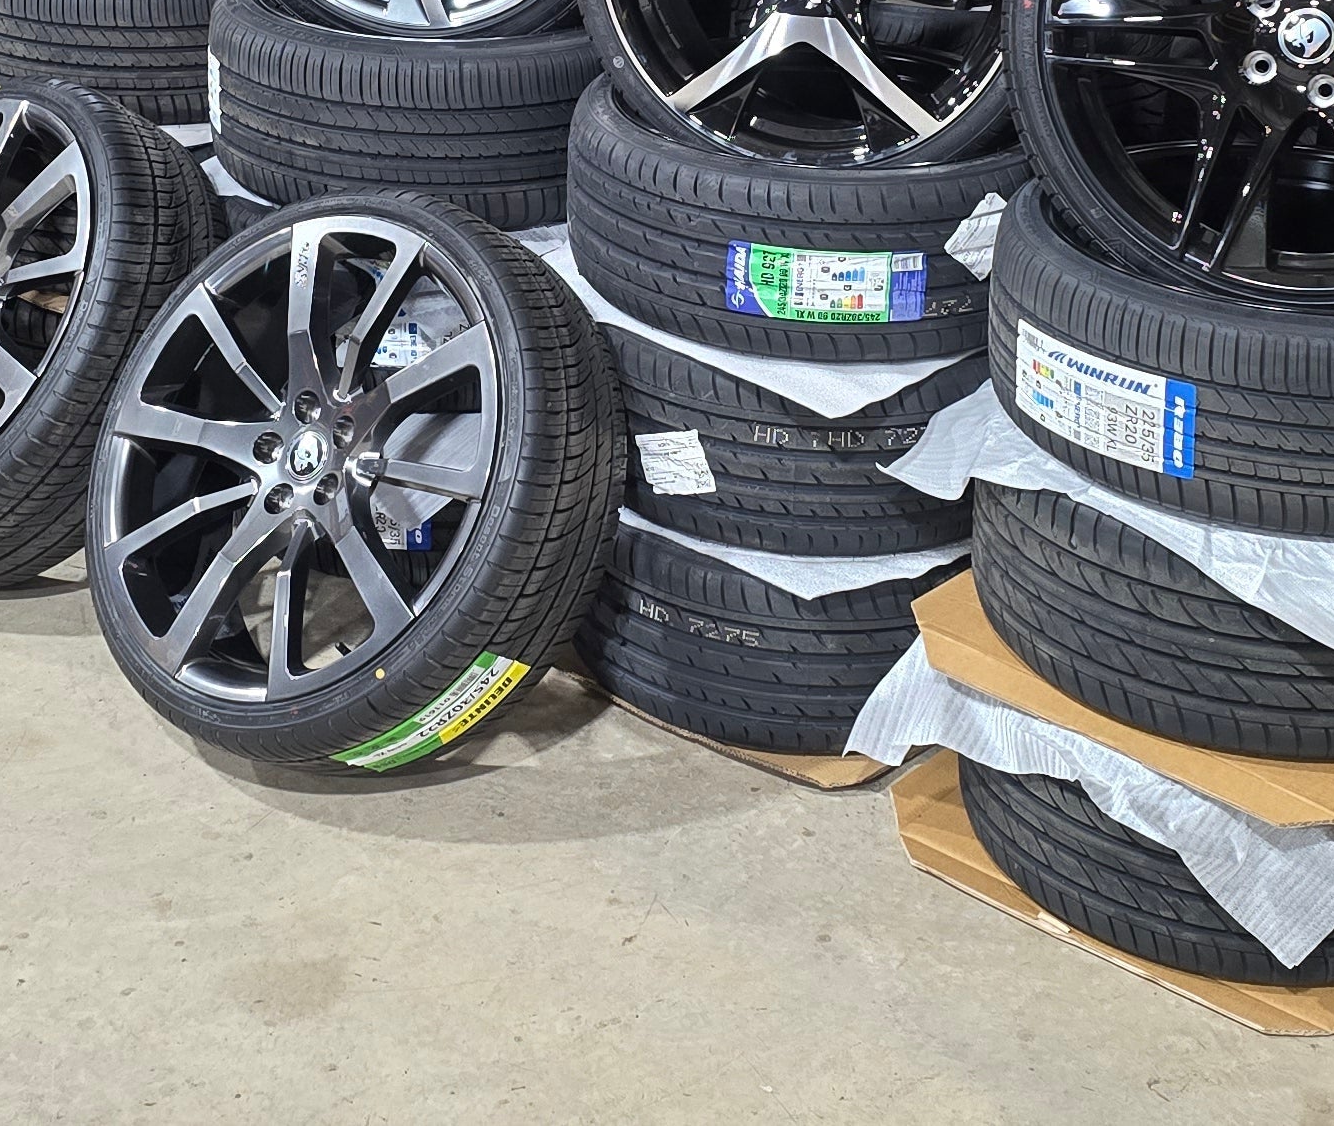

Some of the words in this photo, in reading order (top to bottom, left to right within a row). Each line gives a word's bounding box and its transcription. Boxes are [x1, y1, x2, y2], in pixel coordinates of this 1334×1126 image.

[760, 273, 775, 285] HD
[795, 310, 806, 318] XL
[807, 311, 816, 319] W
[1067, 358, 1151, 395] WINRUN
[1106, 406, 1117, 435] 93W
[1125, 404, 1138, 444] ZR20
[754, 426, 790, 445] HD
[1106, 439, 1117, 452] XL
[1141, 410, 1156, 463] 225/35
[639, 599, 669, 623] HD
[458, 676, 513, 727] DELINTE
